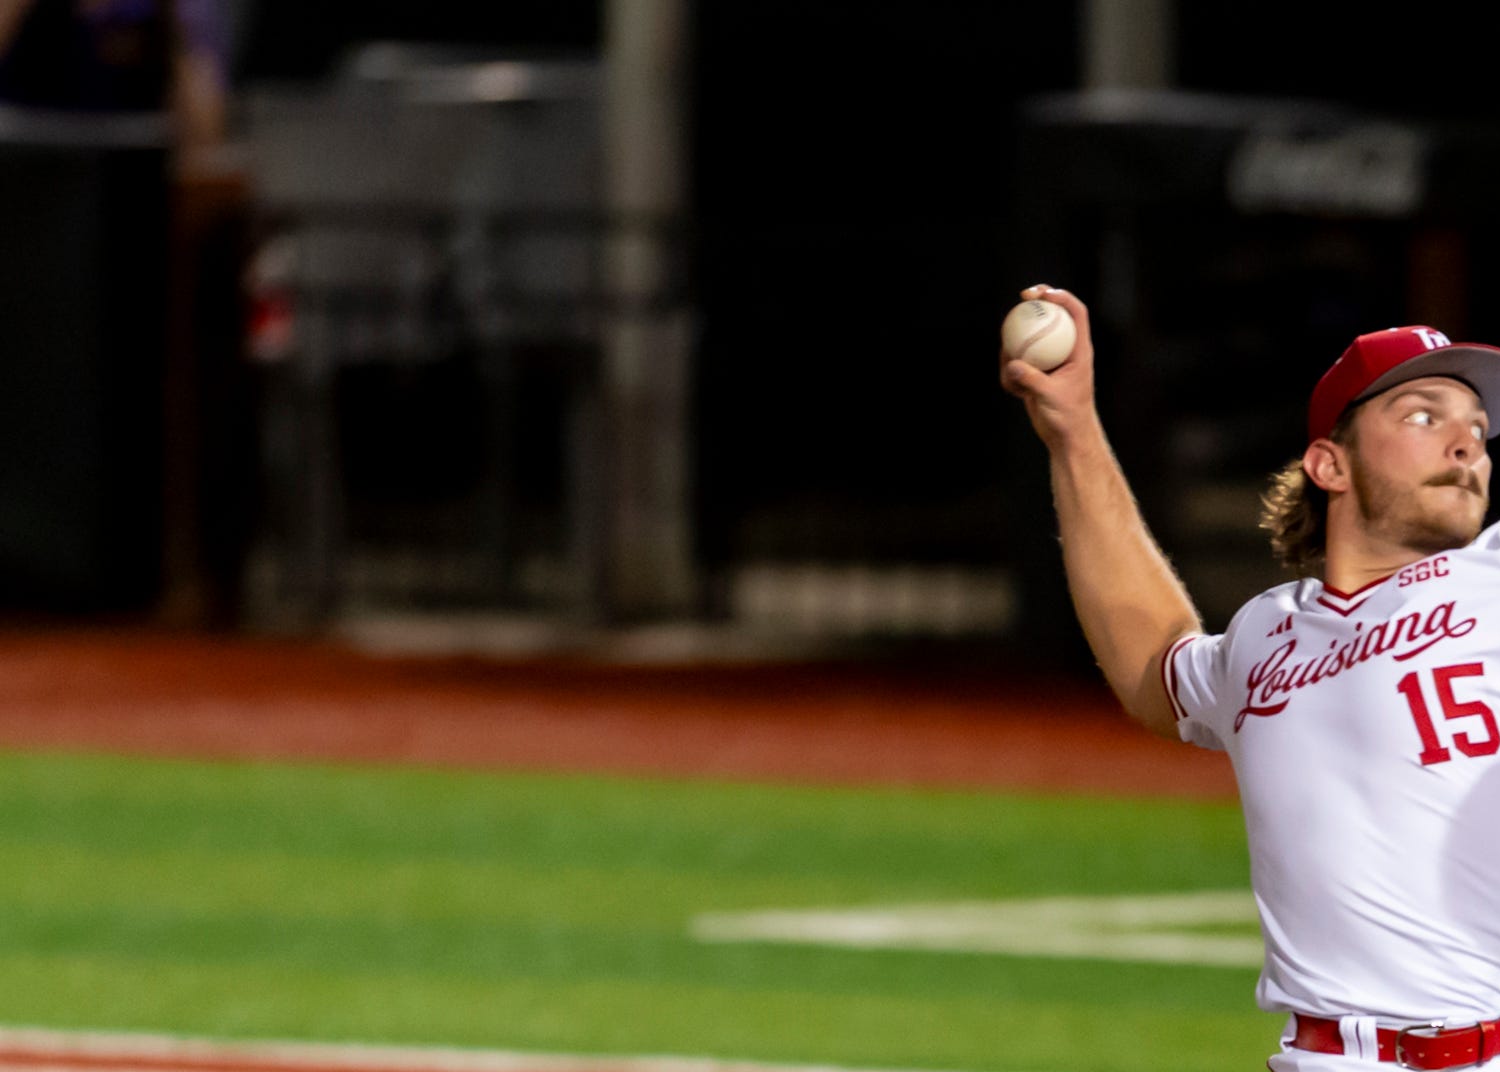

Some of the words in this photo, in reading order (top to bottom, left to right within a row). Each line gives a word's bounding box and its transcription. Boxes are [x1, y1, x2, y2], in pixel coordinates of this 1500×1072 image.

[1398, 556, 1450, 588] SBC
[1233, 601, 1476, 734] Louisiana
[1397, 663, 1500, 765] 15
